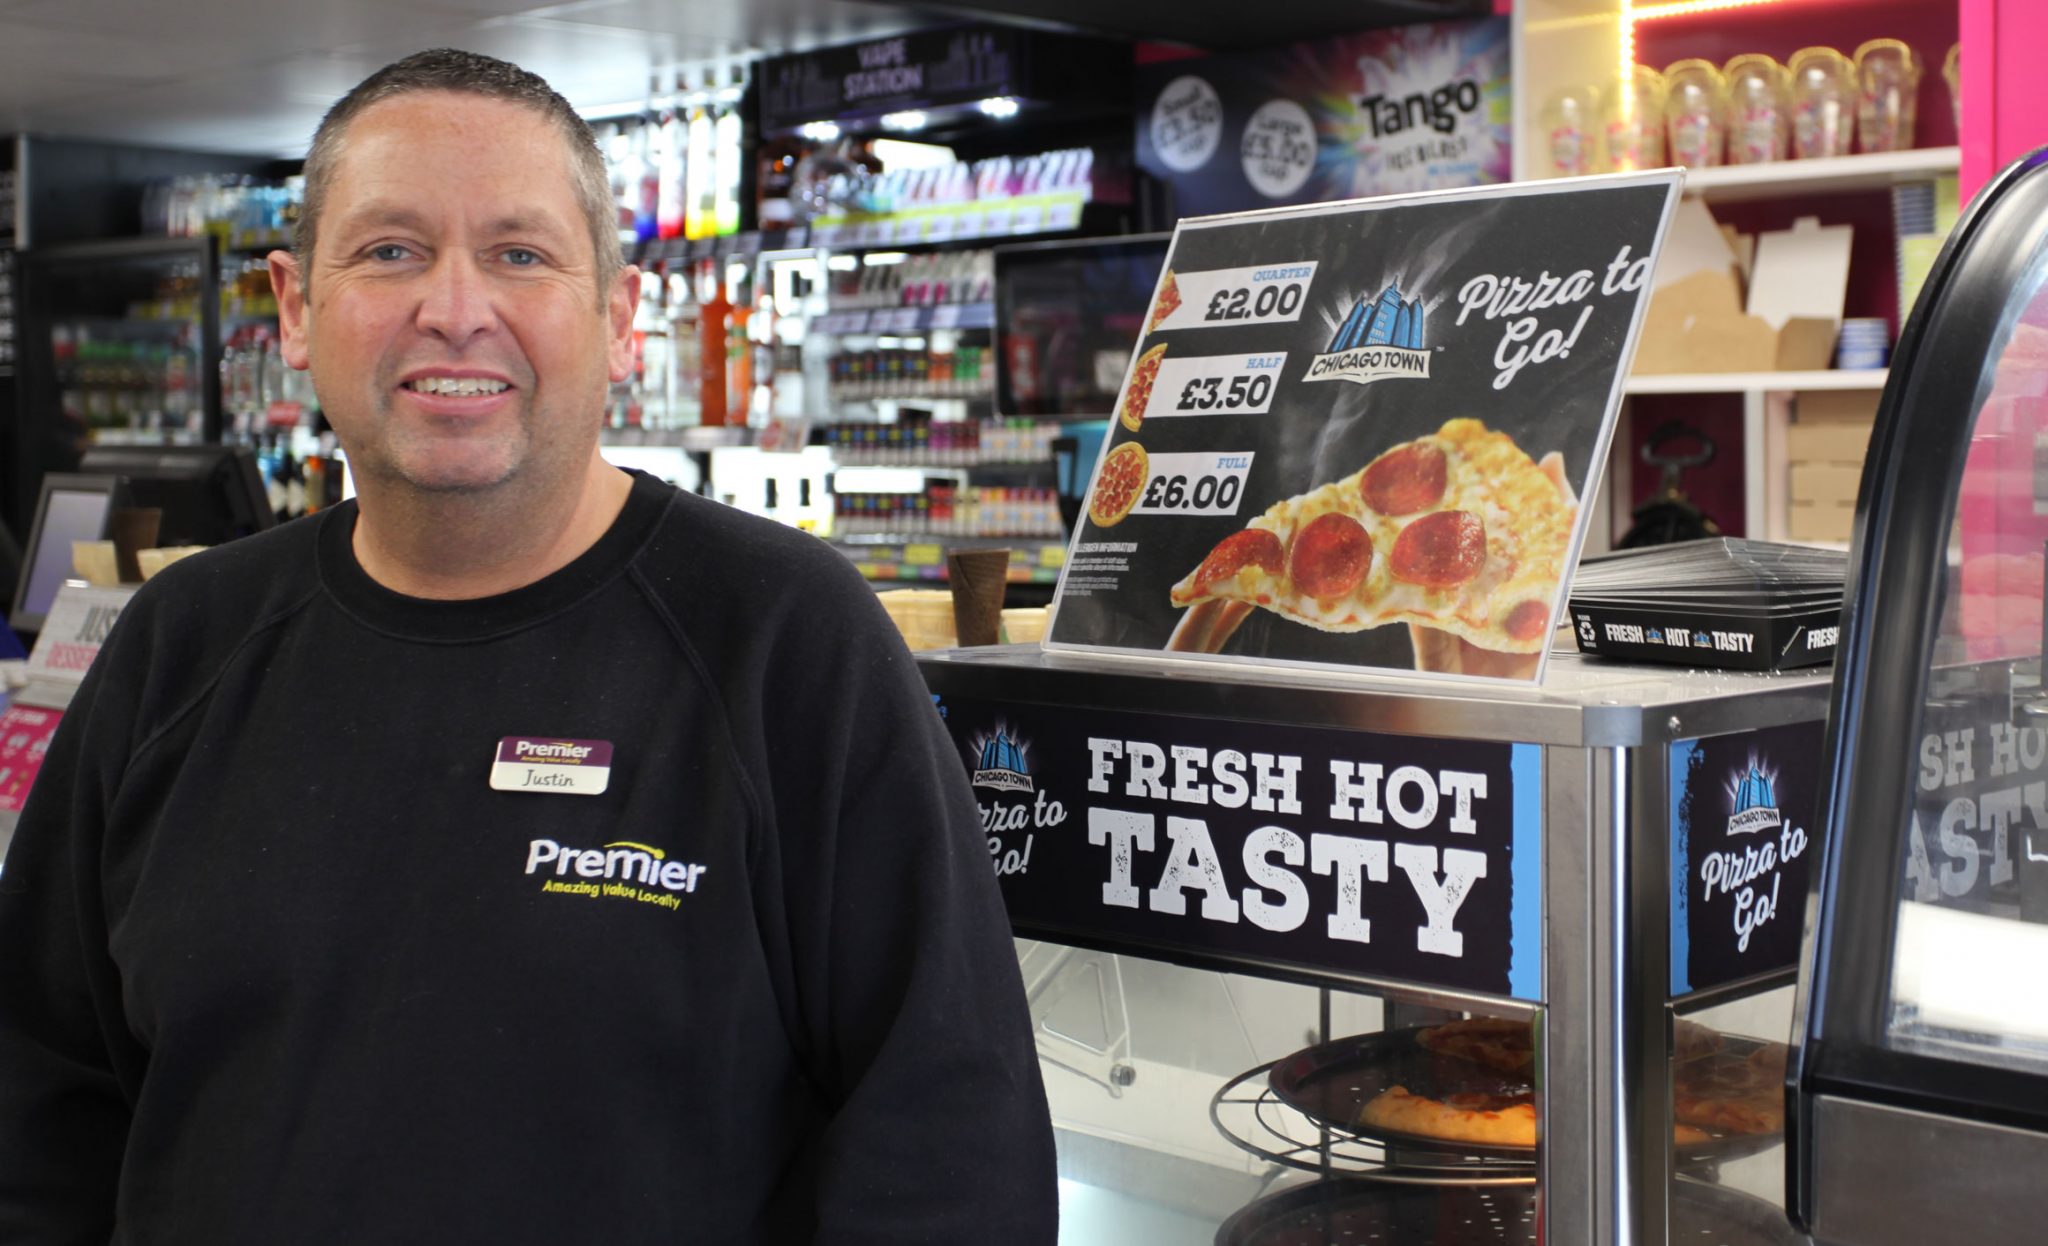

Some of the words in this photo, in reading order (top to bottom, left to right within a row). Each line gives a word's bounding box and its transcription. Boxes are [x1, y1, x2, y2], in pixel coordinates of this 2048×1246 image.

[844, 64, 922, 101] STATION
[1361, 80, 1479, 137] Tango
[1253, 267, 1312, 282] QUARTER
[1456, 270, 1595, 326] Pizza
[1602, 245, 1651, 296] to
[1204, 283, 1302, 321] £2.00
[1246, 357, 1282, 369] HALF
[1311, 352, 1382, 376] CHICAGO
[1385, 351, 1425, 373] TOWN
[1493, 305, 1594, 390] Go!
[1176, 374, 1272, 410] £3.50
[1217, 457, 1247, 469] FULL
[1142, 475, 1240, 509] £6.00
[1605, 624, 1644, 643] FRESH
[1665, 628, 1690, 647] HOT
[1711, 631, 1754, 653] TASTY
[515, 740, 593, 758] Premier
[1990, 722, 2048, 778] HO
[522, 769, 574, 786] Justin
[975, 772, 1008, 784] CHICAGO
[1009, 774, 1031, 789] TOWN
[1088, 737, 1301, 814] FRESH
[1330, 760, 1487, 834] HOT
[977, 800, 1029, 832] zza
[1034, 789, 1067, 828] to
[1729, 811, 1760, 831] CHICAGO
[1760, 810, 1779, 824] TOWN
[525, 839, 706, 893] Premier
[1701, 842, 1777, 902] Pizza
[1780, 818, 1808, 864] to
[543, 880, 600, 898] Amazing
[602, 882, 636, 898] Value
[637, 890, 681, 910] Locally
[1088, 807, 1487, 957] TASTY
[1734, 872, 1781, 953] Go!
